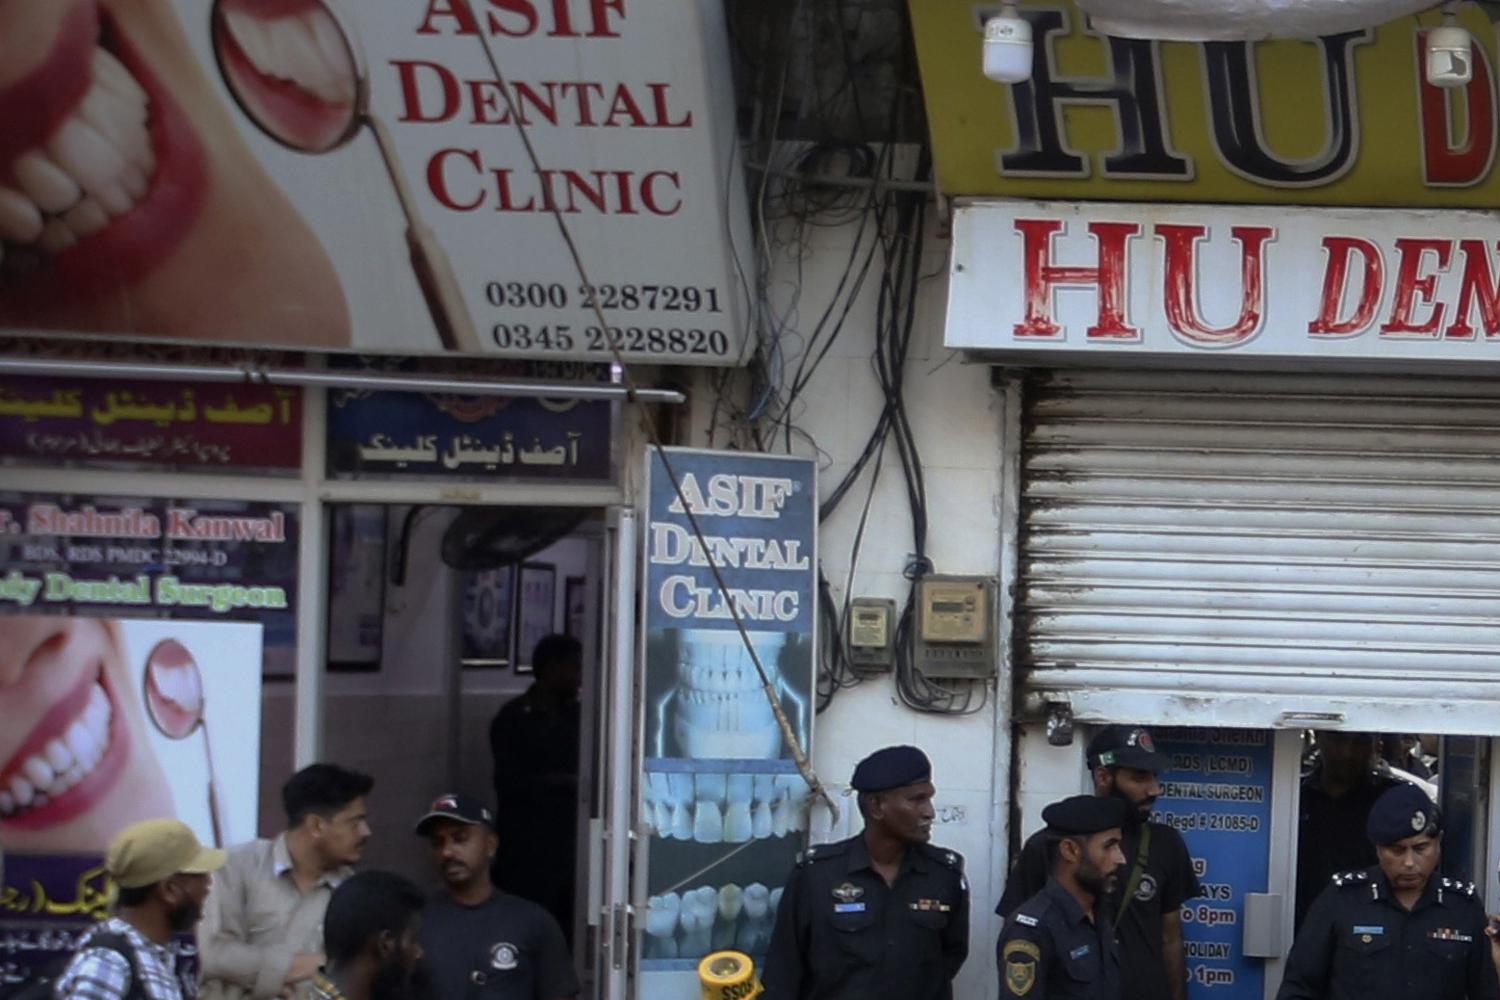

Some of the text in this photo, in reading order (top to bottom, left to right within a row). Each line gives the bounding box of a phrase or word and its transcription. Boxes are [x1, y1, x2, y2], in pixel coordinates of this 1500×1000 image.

[388, 59, 693, 129] DENTAL
[976, 2, 1376, 190] HU
[424, 147, 684, 218] CLINIC
[485, 281, 723, 314] 0300 2287291
[1011, 217, 1278, 349] HU
[492, 323, 729, 357] 0345 2228820
[668, 472, 793, 519] ASIF
[167, 507, 286, 543] Kanwal
[650, 521, 810, 571] DENTAL
[44, 572, 151, 605] Dental
[157, 575, 288, 613] Surgeon
[660, 574, 800, 623] CLINIC
[1159, 782, 1265, 802] DENTAL SURGEON
[1210, 814, 1260, 832] 21085-D
[1198, 906, 1236, 927] 8pm
[1195, 965, 1233, 987] 1pm
